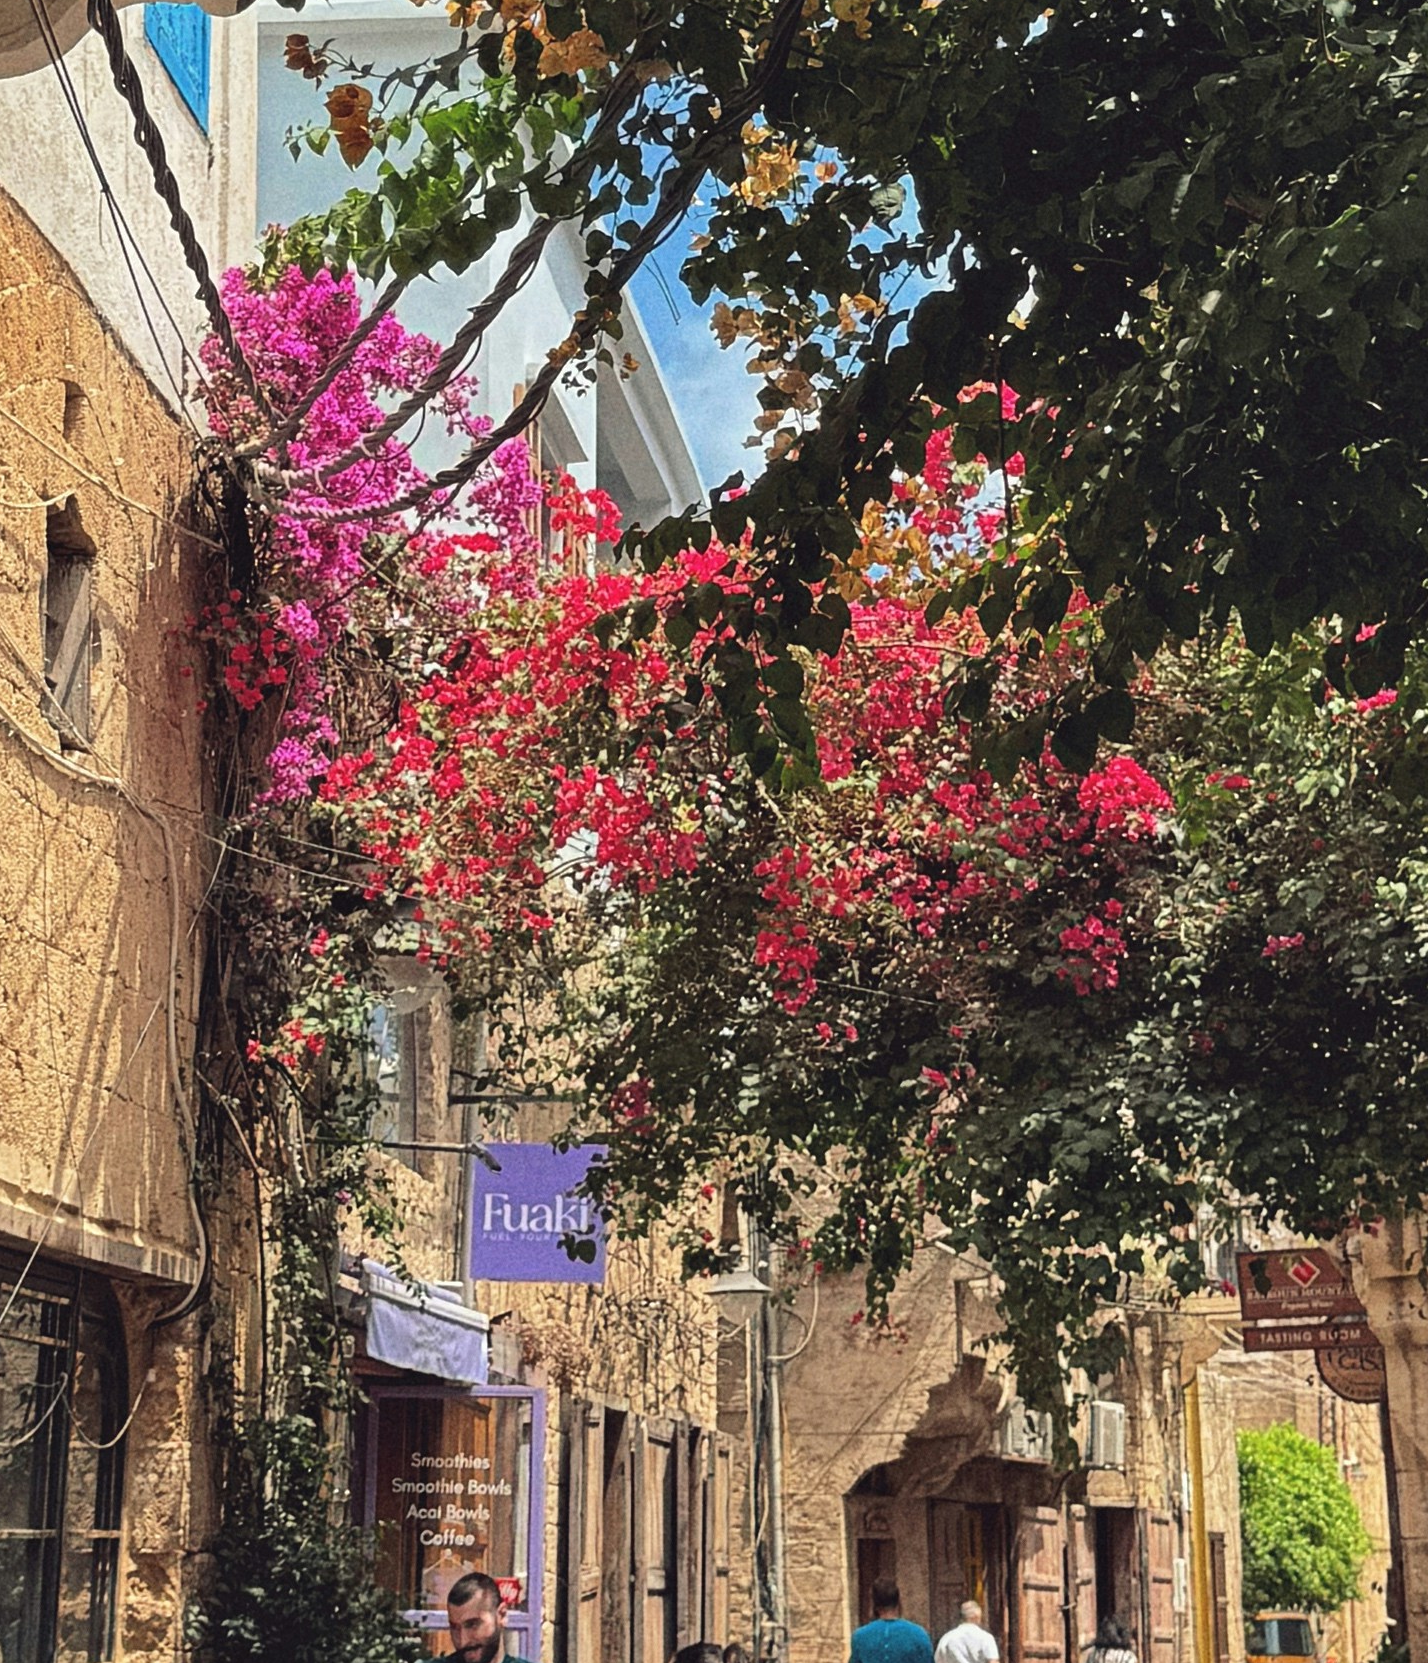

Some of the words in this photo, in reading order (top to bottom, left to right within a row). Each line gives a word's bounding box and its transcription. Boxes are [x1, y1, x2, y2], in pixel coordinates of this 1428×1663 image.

[483, 1193, 588, 1233] Fuaki
[1260, 1331, 1313, 1344] TASTING
[411, 1452, 491, 1470] Smoothies
[392, 1478, 464, 1494] Smoothie
[468, 1479, 512, 1496] Bowls
[446, 1504, 491, 1520] Bowls
[420, 1530, 475, 1546] Coffee
